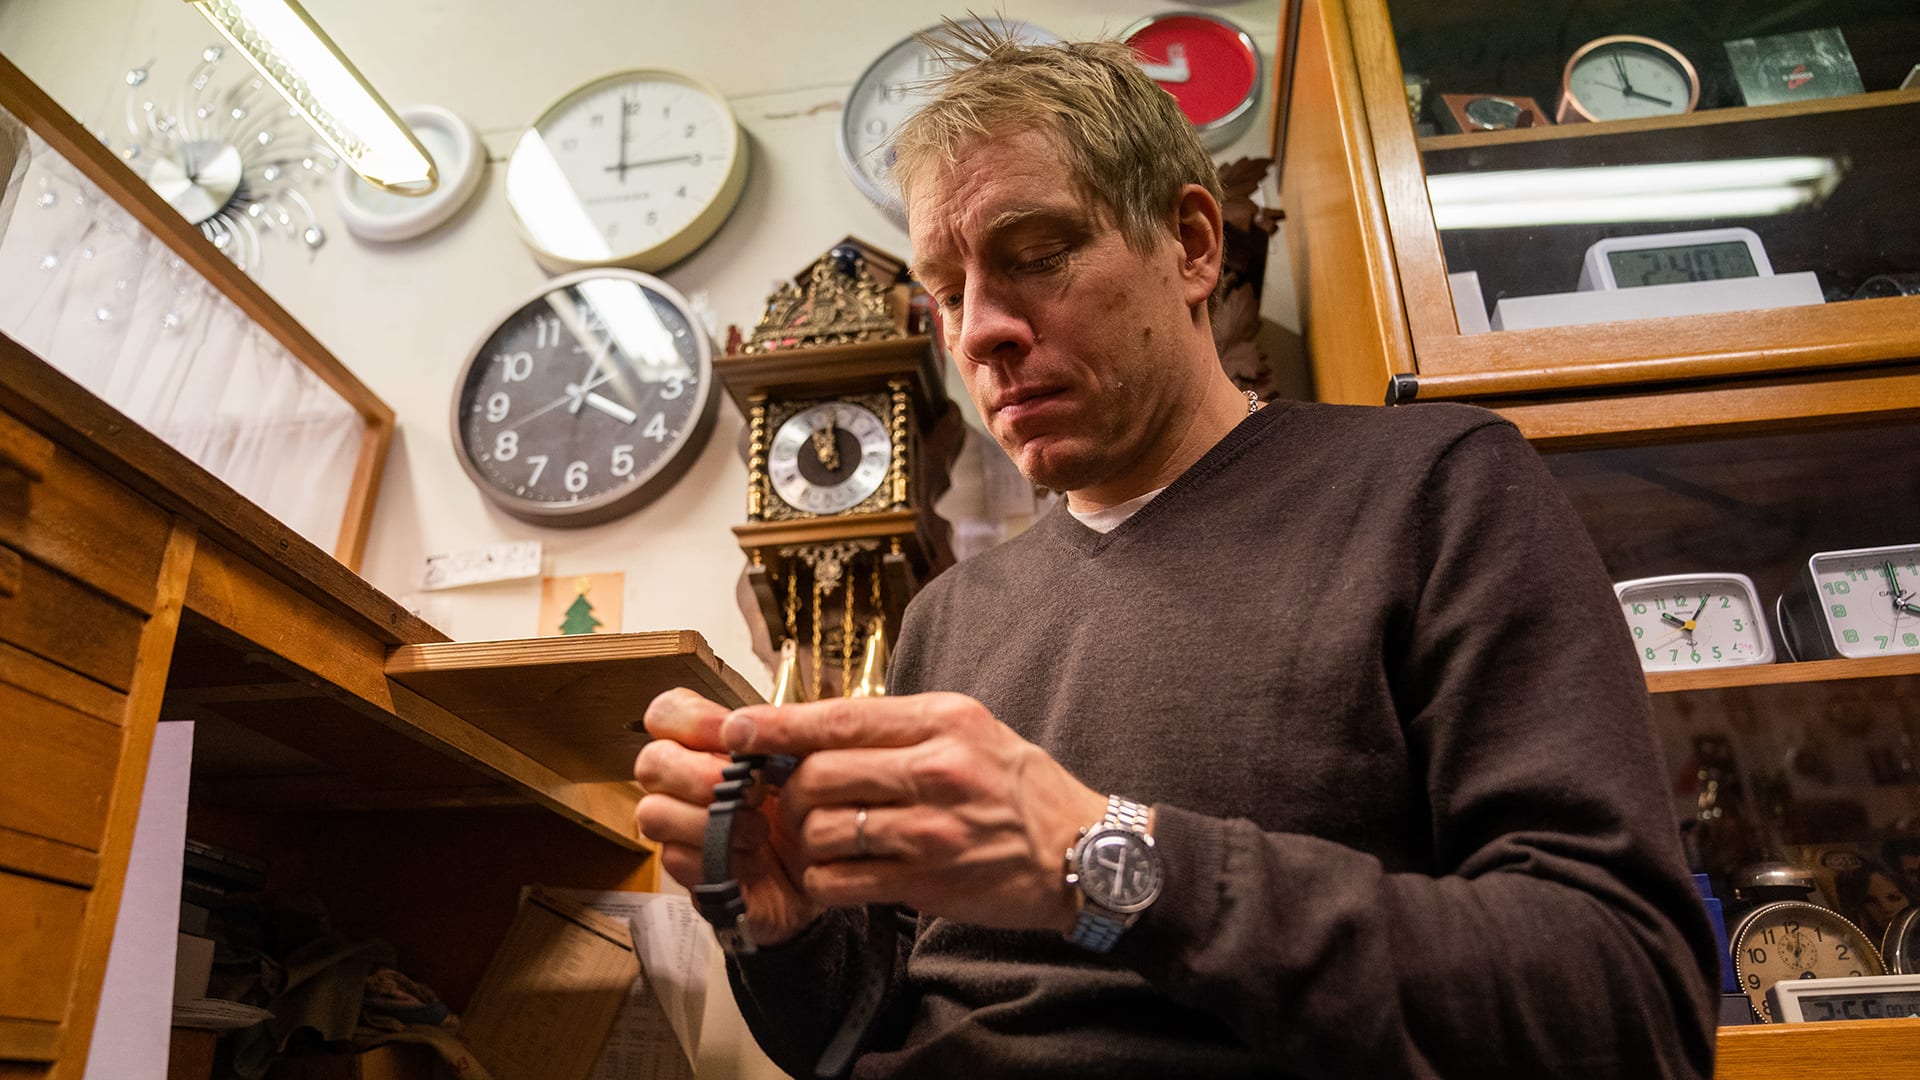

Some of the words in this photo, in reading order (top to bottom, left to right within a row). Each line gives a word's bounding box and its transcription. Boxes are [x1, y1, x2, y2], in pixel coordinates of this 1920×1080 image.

[684, 124, 696, 138] 2
[676, 185, 687, 198] 4
[536, 319, 561, 348] 11
[501, 352, 534, 383] 10
[659, 372, 685, 400] 3
[486, 392, 511, 423] 9
[642, 412, 669, 443] 4
[494, 430, 519, 462] 8
[610, 445, 635, 477] 5
[527, 455, 548, 487] 7
[564, 461, 589, 493] 6
[1846, 567, 1869, 582] 11
[1906, 562, 1919, 577] 1
[1823, 580, 1850, 595] 10
[1655, 598, 1667, 610] 11
[1674, 595, 1688, 607] 12
[1720, 596, 1731, 608] 2
[1632, 603, 1647, 615] 10
[1831, 604, 1847, 618] 9
[1633, 626, 1644, 639] 9
[1733, 619, 1744, 632] 3
[1843, 629, 1859, 643] 8
[1874, 635, 1889, 650] 7
[1903, 632, 1919, 647] 6
[1645, 647, 1656, 660] 8
[1670, 649, 1678, 662] 7
[1690, 649, 1701, 662] 6
[1712, 646, 1722, 659] 5
[1782, 921, 1800, 934] 12
[1814, 927, 1822, 942] 1
[1761, 929, 1775, 944] 11
[1747, 948, 1767, 964] 10
[1835, 944, 1850, 960] 2
[1747, 974, 1760, 989] 9
